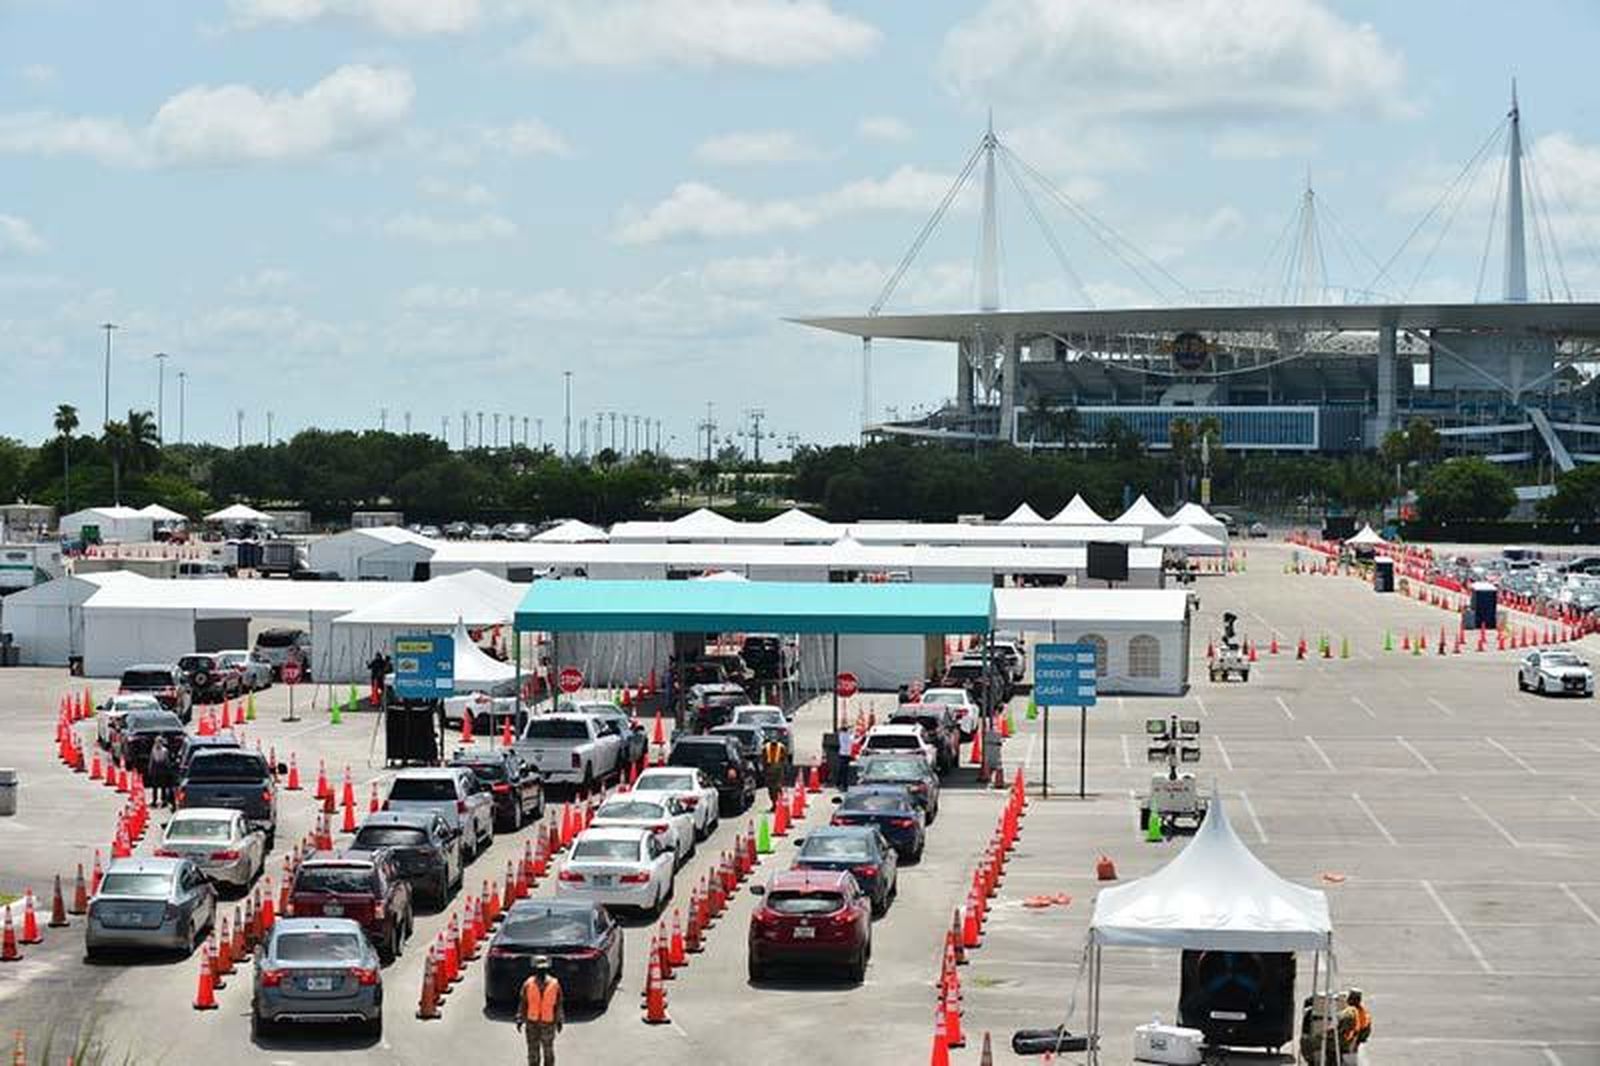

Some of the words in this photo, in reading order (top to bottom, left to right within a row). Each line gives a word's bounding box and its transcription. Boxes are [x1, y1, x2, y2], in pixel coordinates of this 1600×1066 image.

[1037, 653, 1074, 662] PREPAID
[1036, 669, 1071, 679] CREDIT
[561, 674, 581, 686] STOP
[1035, 685, 1063, 695] CASH
